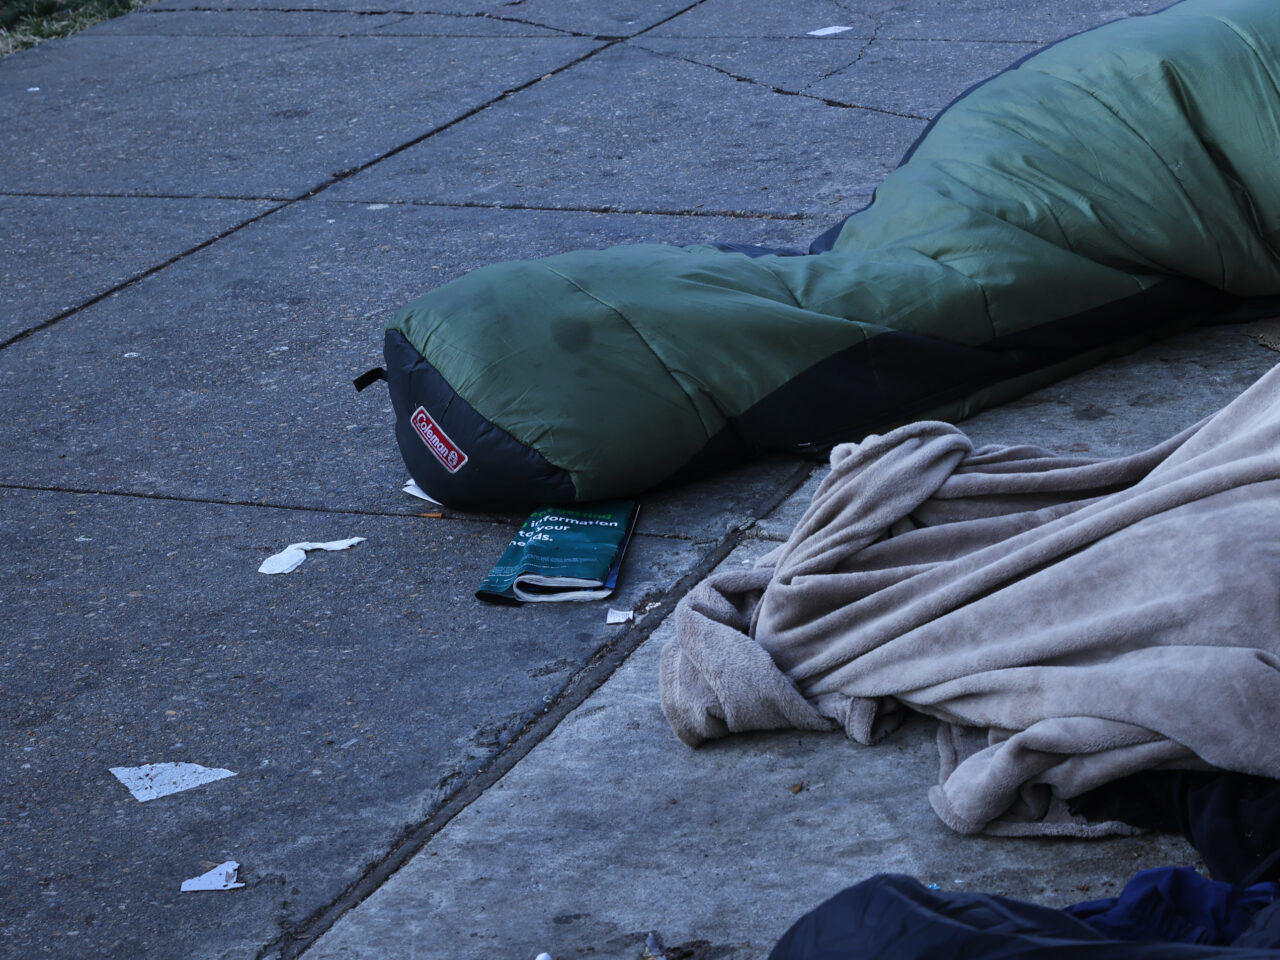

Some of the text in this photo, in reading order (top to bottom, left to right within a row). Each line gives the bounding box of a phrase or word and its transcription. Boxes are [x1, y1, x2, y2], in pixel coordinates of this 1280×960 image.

[416, 413, 449, 457] Coleman
[530, 515, 618, 527] information
[536, 524, 571, 532] your
